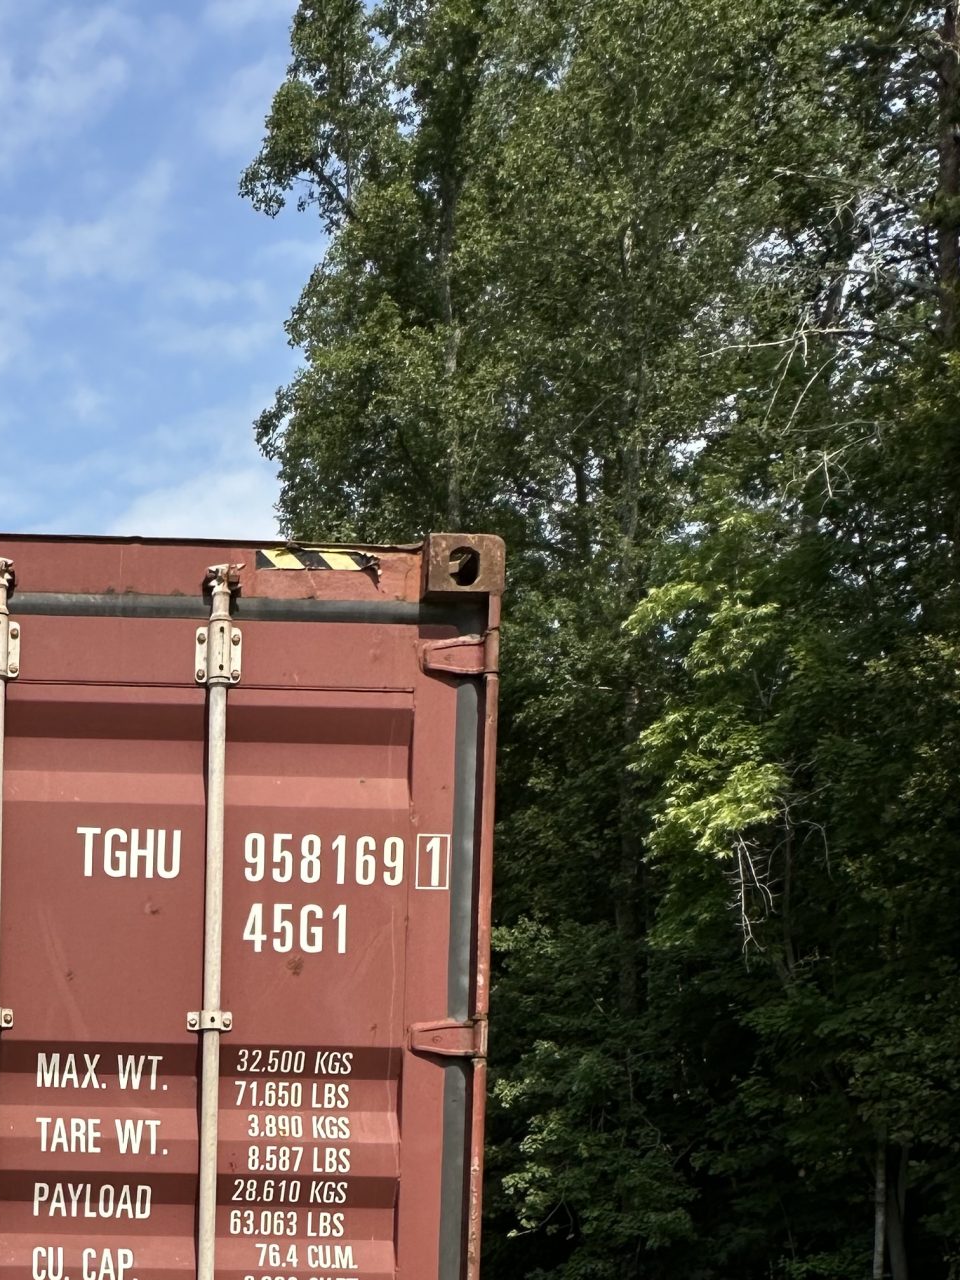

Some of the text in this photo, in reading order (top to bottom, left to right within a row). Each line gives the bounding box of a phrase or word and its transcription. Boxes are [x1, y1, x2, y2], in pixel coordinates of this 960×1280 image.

[76, 827, 441, 887] TGHU 958169 1
[242, 903, 347, 954] 45G1
[36, 1052, 168, 1091] MAX. WT.
[236, 1049, 353, 1075] 32,500 KGS
[234, 1081, 350, 1109] 71,650 LBS
[35, 1117, 168, 1156] TARE WT.
[311, 1115, 351, 1139] KGS
[247, 1145, 351, 1173] 8,587 LBS
[32, 1183, 152, 1220] PAYLOAD
[231, 1178, 348, 1204] 28,610 KGS
[230, 1210, 345, 1237] 63,063 LBS
[255, 1243, 299, 1268] 76.4
